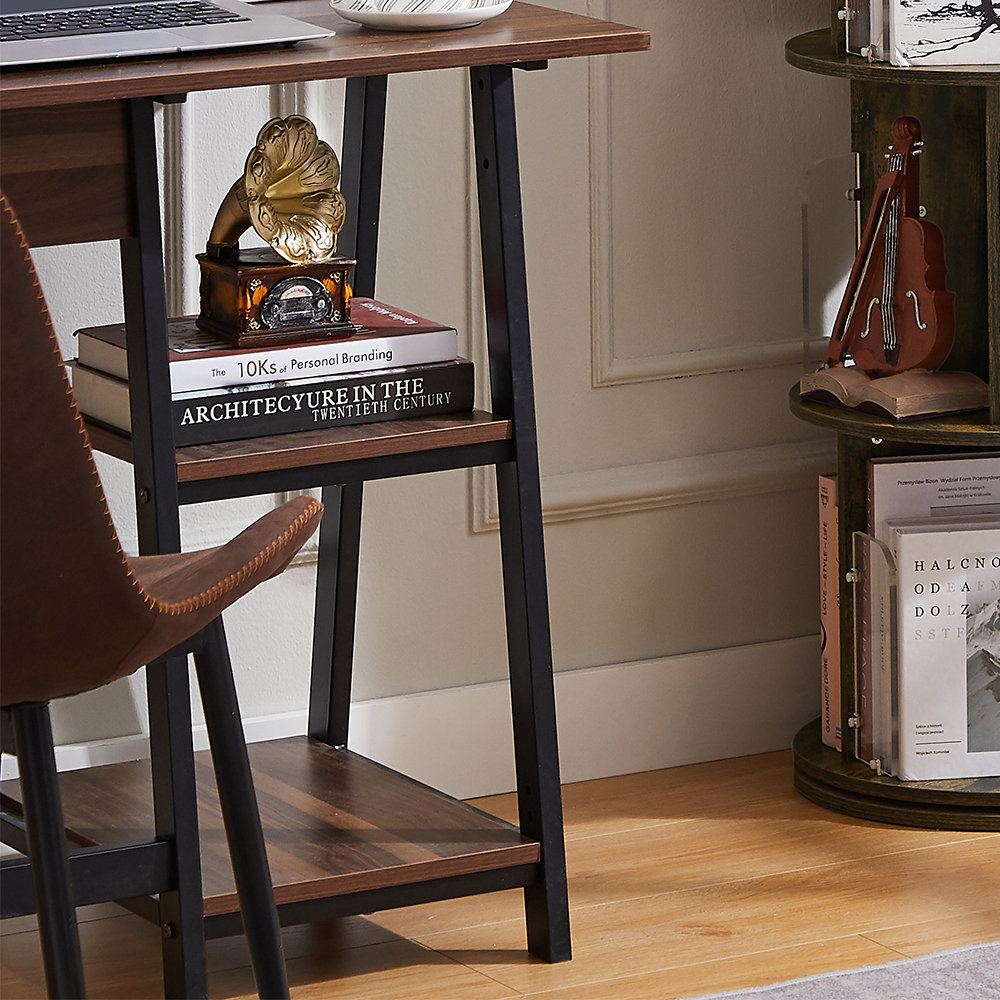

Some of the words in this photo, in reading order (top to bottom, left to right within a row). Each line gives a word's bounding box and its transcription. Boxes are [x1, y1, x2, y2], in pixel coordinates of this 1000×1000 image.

[211, 368, 226, 377] The
[237, 359, 277, 378] 10Ks
[279, 366, 287, 374] of
[291, 353, 339, 371] Personal
[342, 349, 393, 365] Branding
[180, 387, 349, 426] ARCHITECYURE
[353, 384, 377, 402] IN
[380, 377, 424, 398] THE
[311, 396, 388, 422] TWENTIETH
[393, 391, 452, 411] CENTURY
